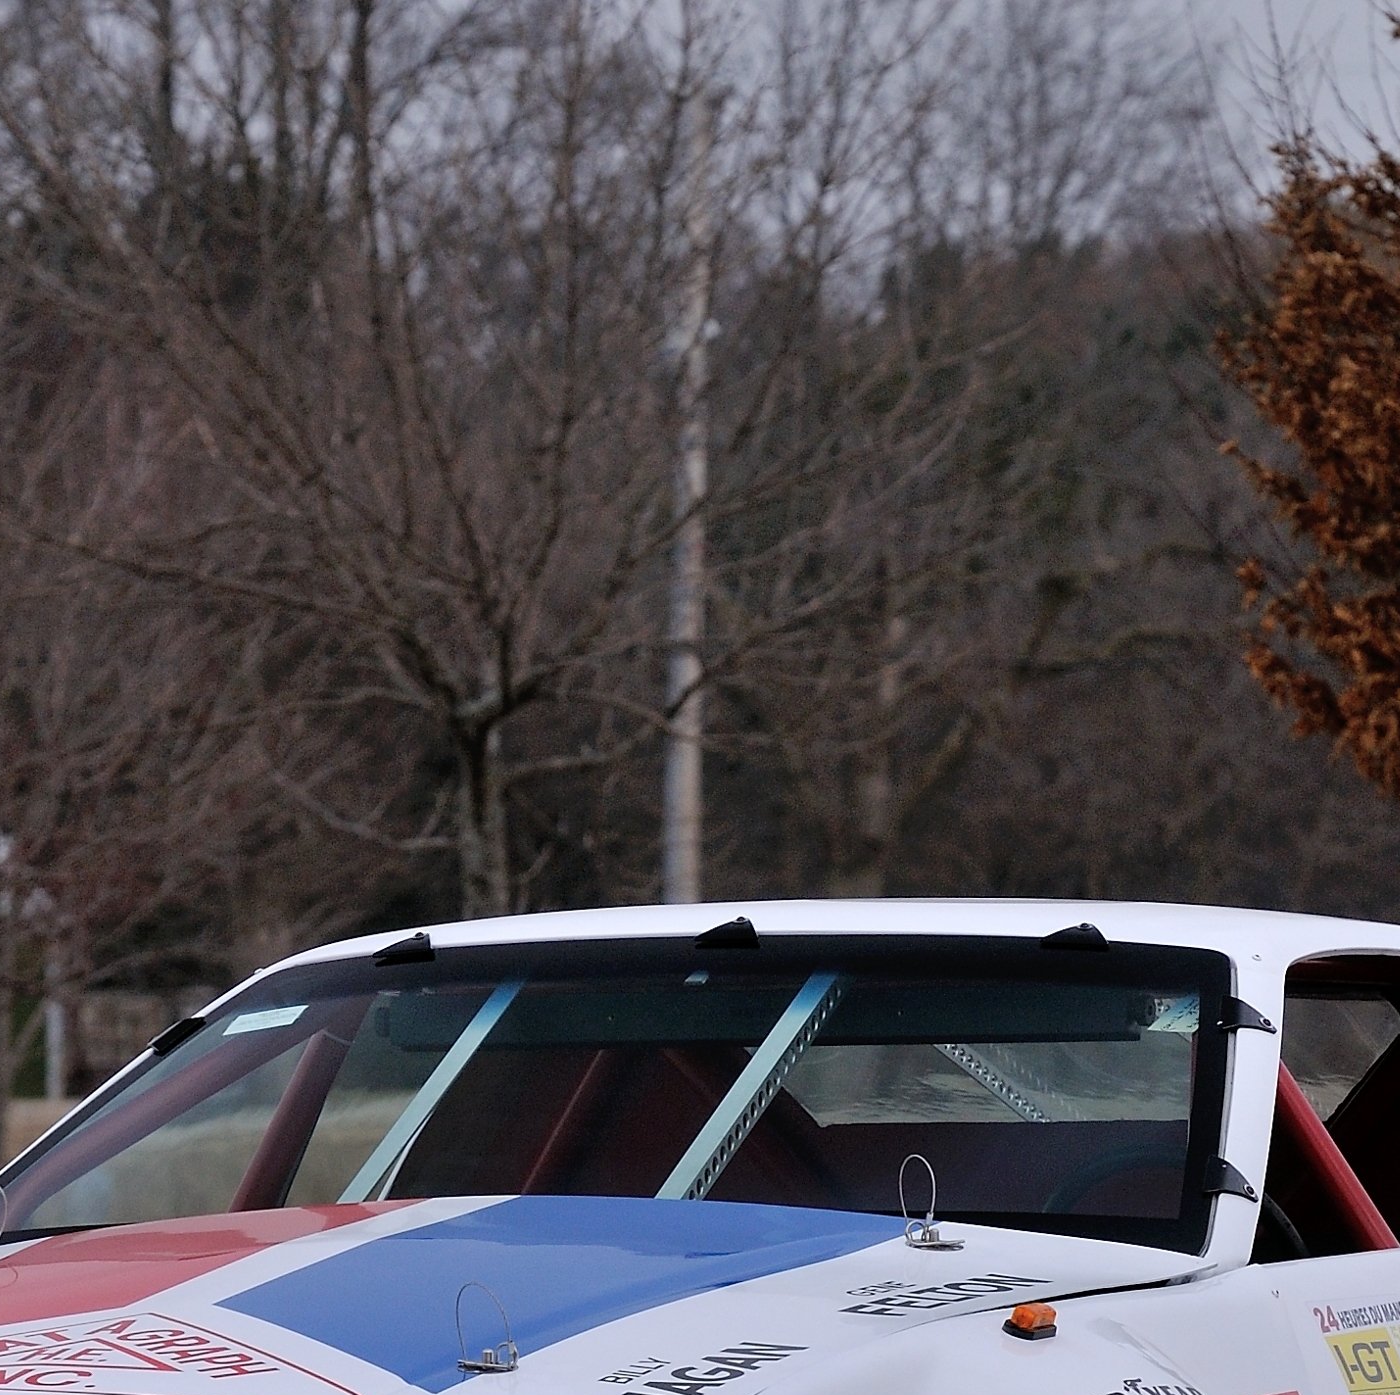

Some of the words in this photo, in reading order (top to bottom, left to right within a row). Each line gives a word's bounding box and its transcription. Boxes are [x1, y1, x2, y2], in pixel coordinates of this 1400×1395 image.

[837, 1273, 1054, 1316] FELTON
[1313, 1305, 1340, 1333] 24
[1337, 1308, 1372, 1329] HEURES
[1369, 1304, 1384, 1324] DU
[598, 1356, 671, 1385] BILLY
